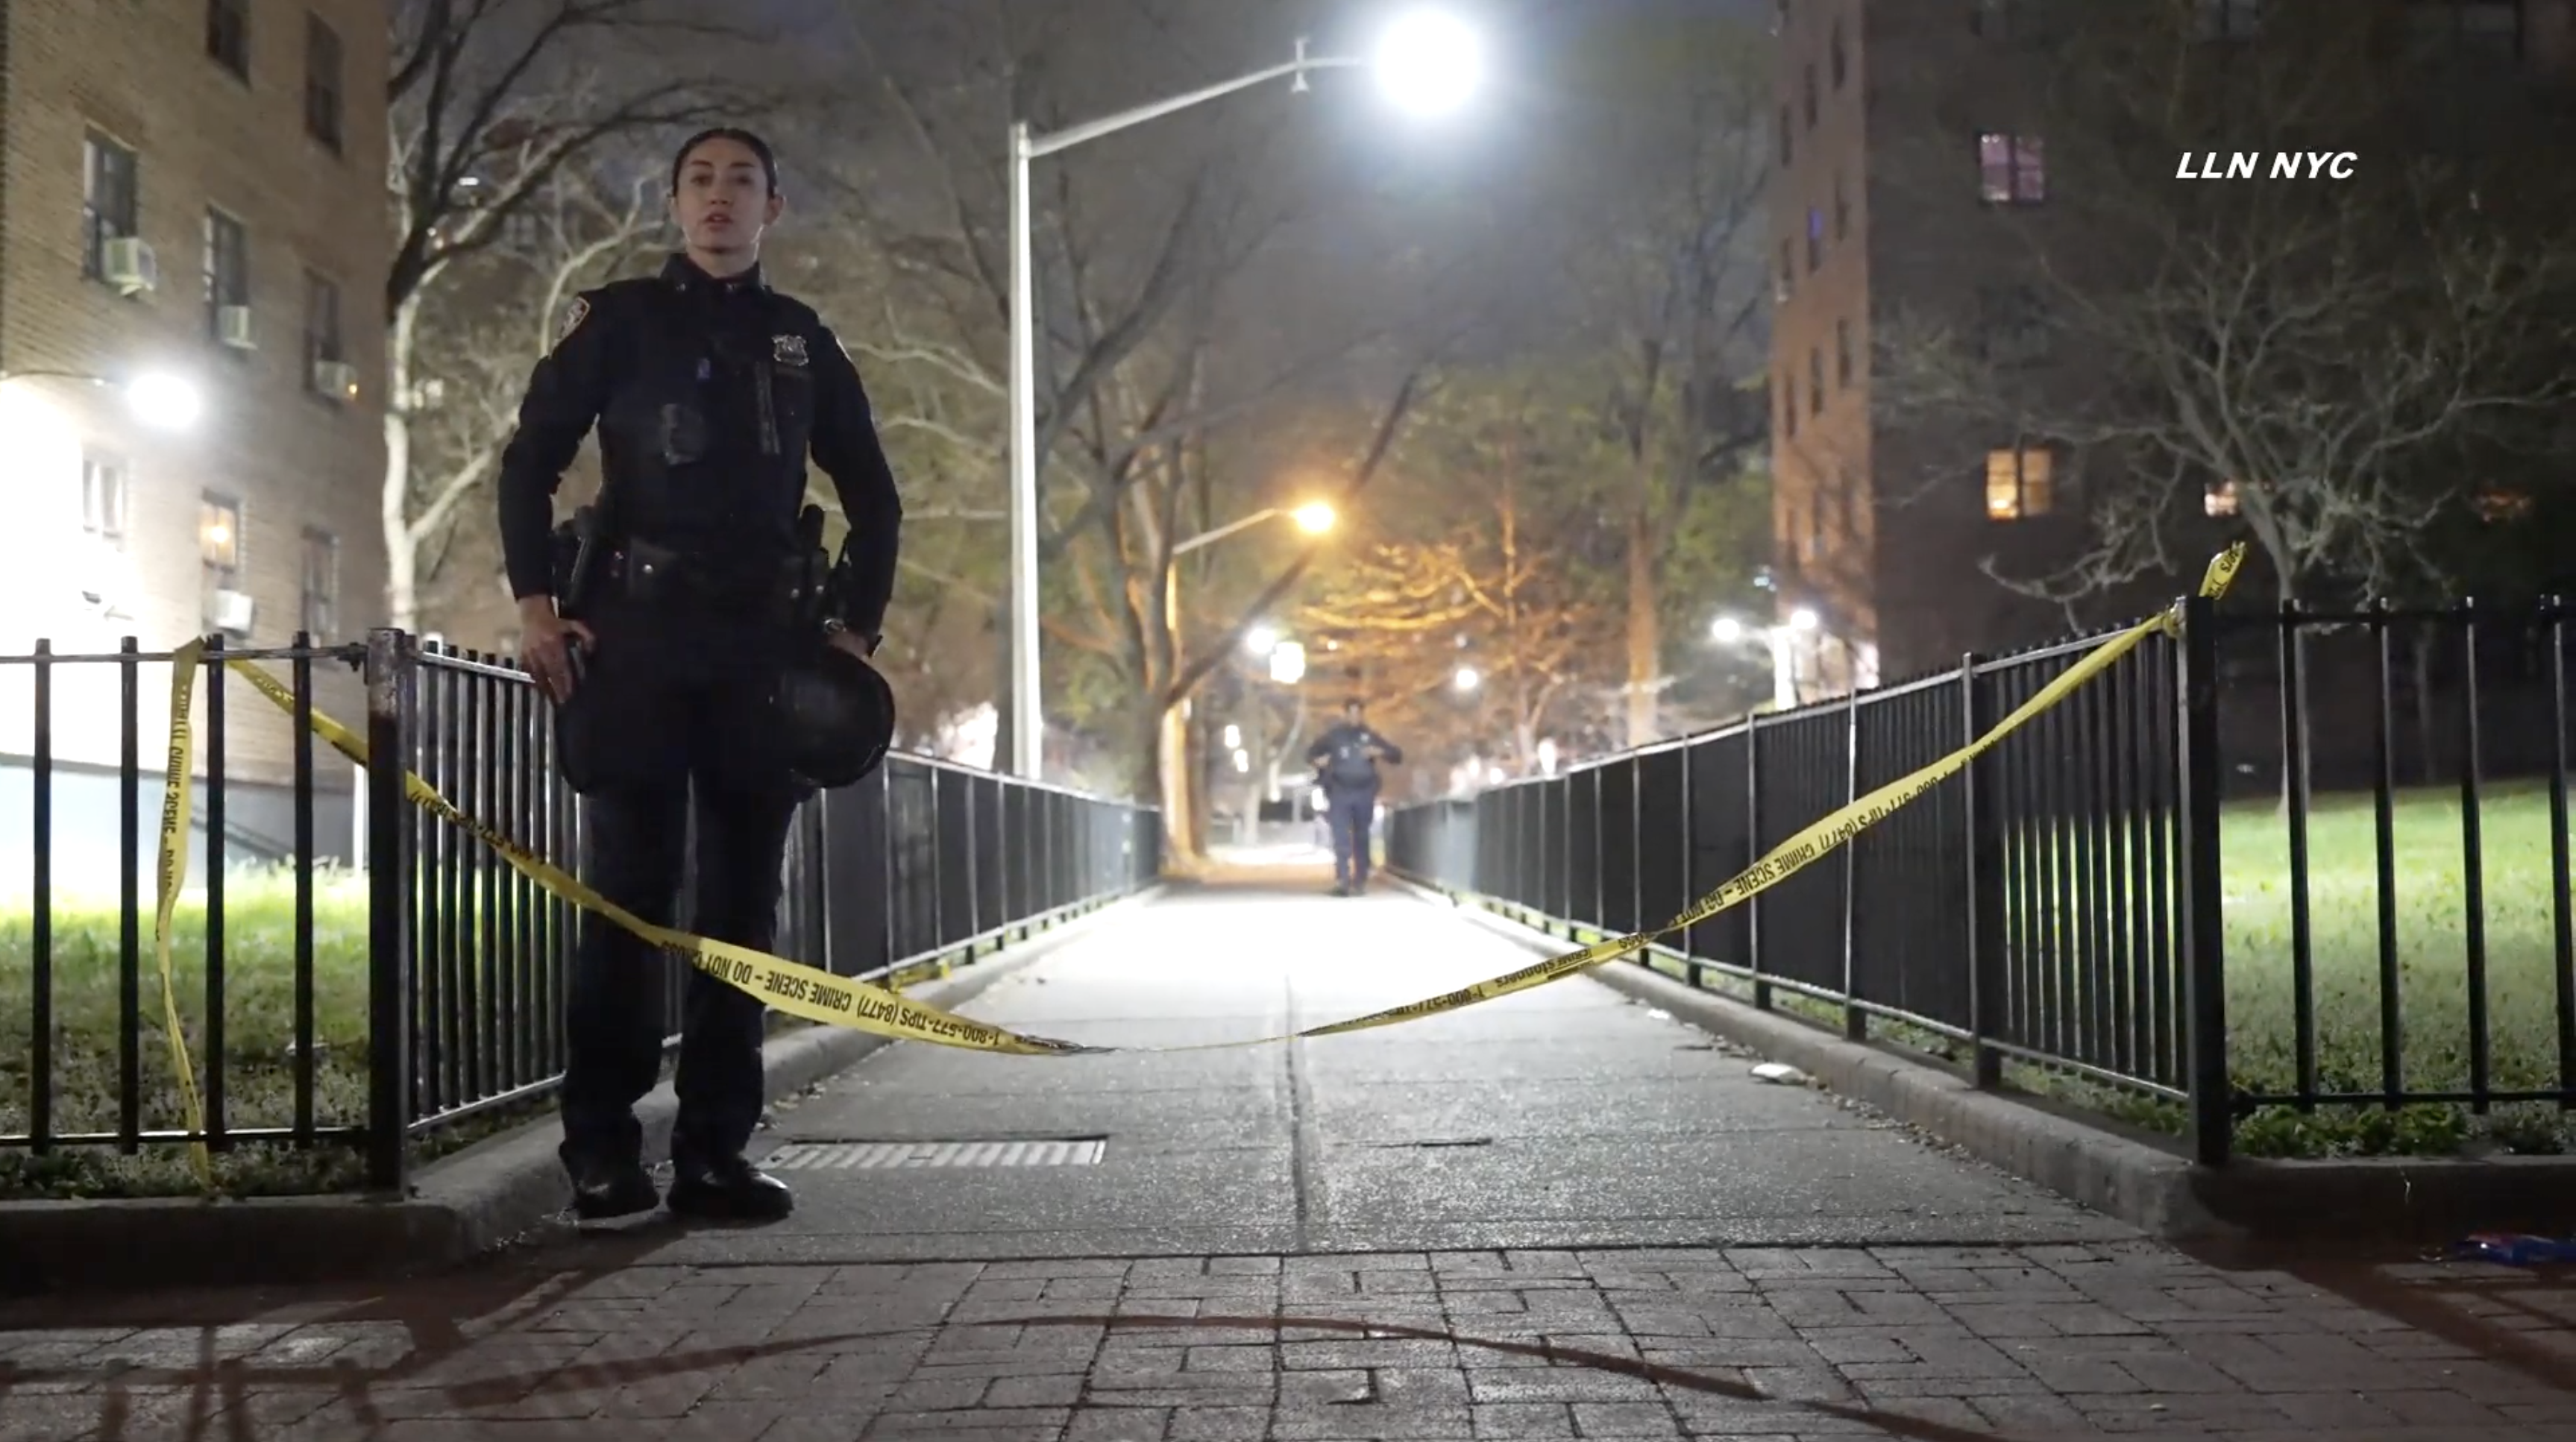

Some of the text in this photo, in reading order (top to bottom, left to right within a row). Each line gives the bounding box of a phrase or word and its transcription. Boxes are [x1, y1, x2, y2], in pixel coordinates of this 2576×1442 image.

[1734, 863, 1776, 895] SCENE
[733, 960, 753, 985] DO
[764, 971, 808, 1001] SCENE
[808, 983, 852, 1013] CRIME
[857, 994, 899, 1026] (8477)
[899, 1007, 1000, 1047] 1-800-577-TIPS
